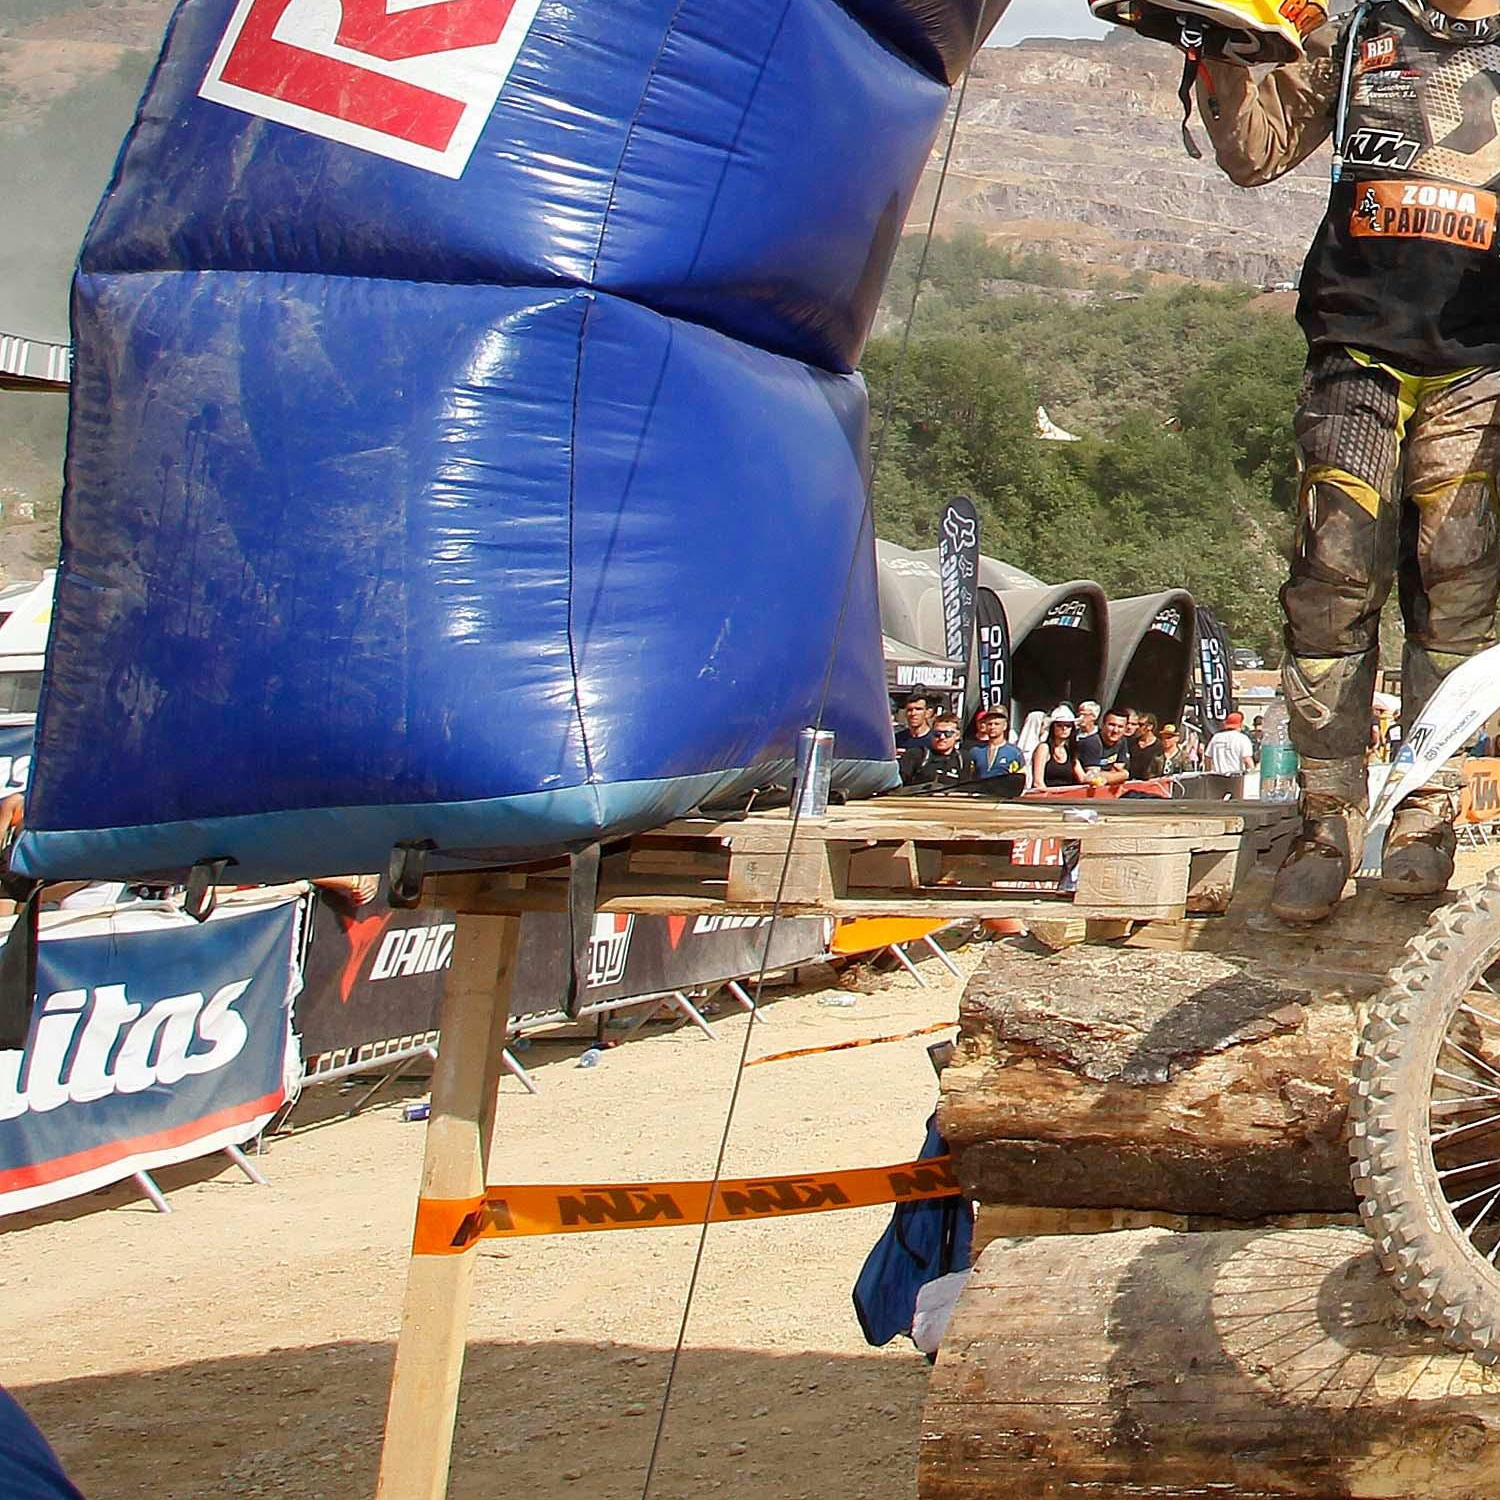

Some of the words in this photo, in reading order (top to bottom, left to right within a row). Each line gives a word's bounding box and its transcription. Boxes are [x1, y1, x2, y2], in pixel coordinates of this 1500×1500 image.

[1367, 37, 1394, 59] RED
[1343, 127, 1420, 170] KTM
[1401, 184, 1477, 214] ZONA
[1383, 206, 1489, 246] PADDOCK
[0, 978, 253, 1120] itas
